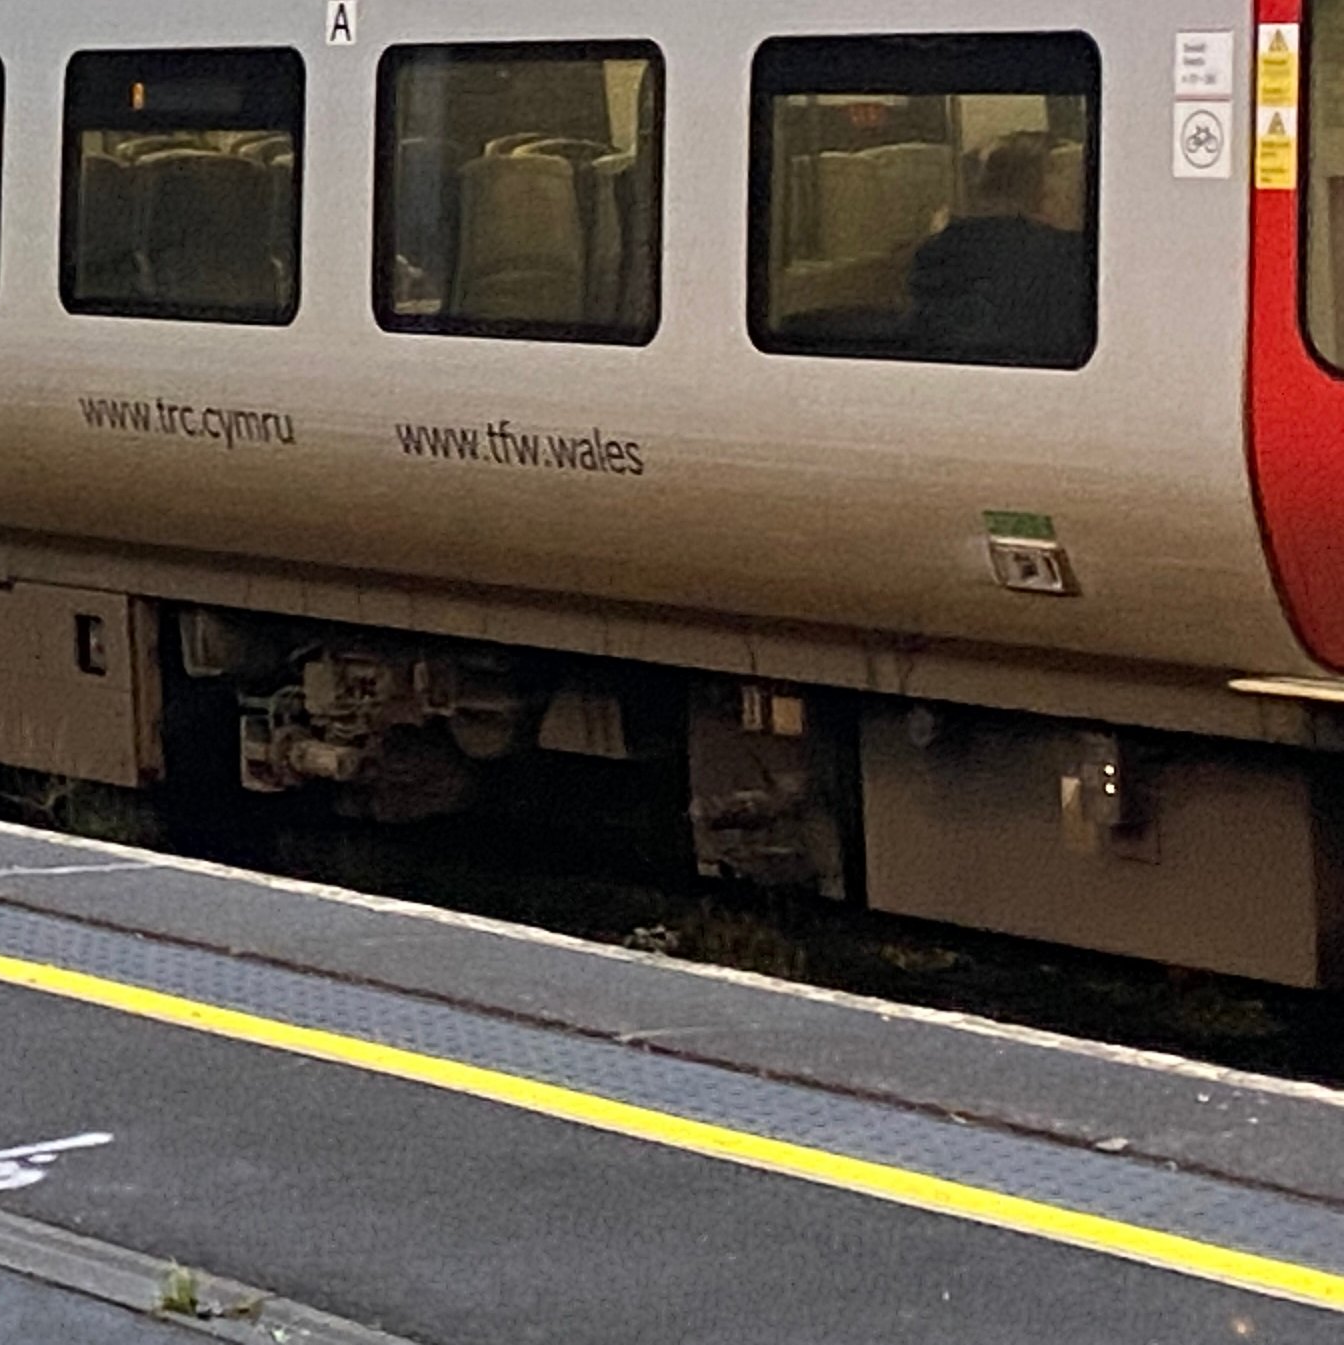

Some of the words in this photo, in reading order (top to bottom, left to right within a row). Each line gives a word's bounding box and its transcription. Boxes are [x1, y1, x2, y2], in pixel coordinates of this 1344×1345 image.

[330, 2, 351, 42] A
[78, 396, 295, 449] www.trc.cymru
[395, 419, 645, 476] www.tfw.wales
